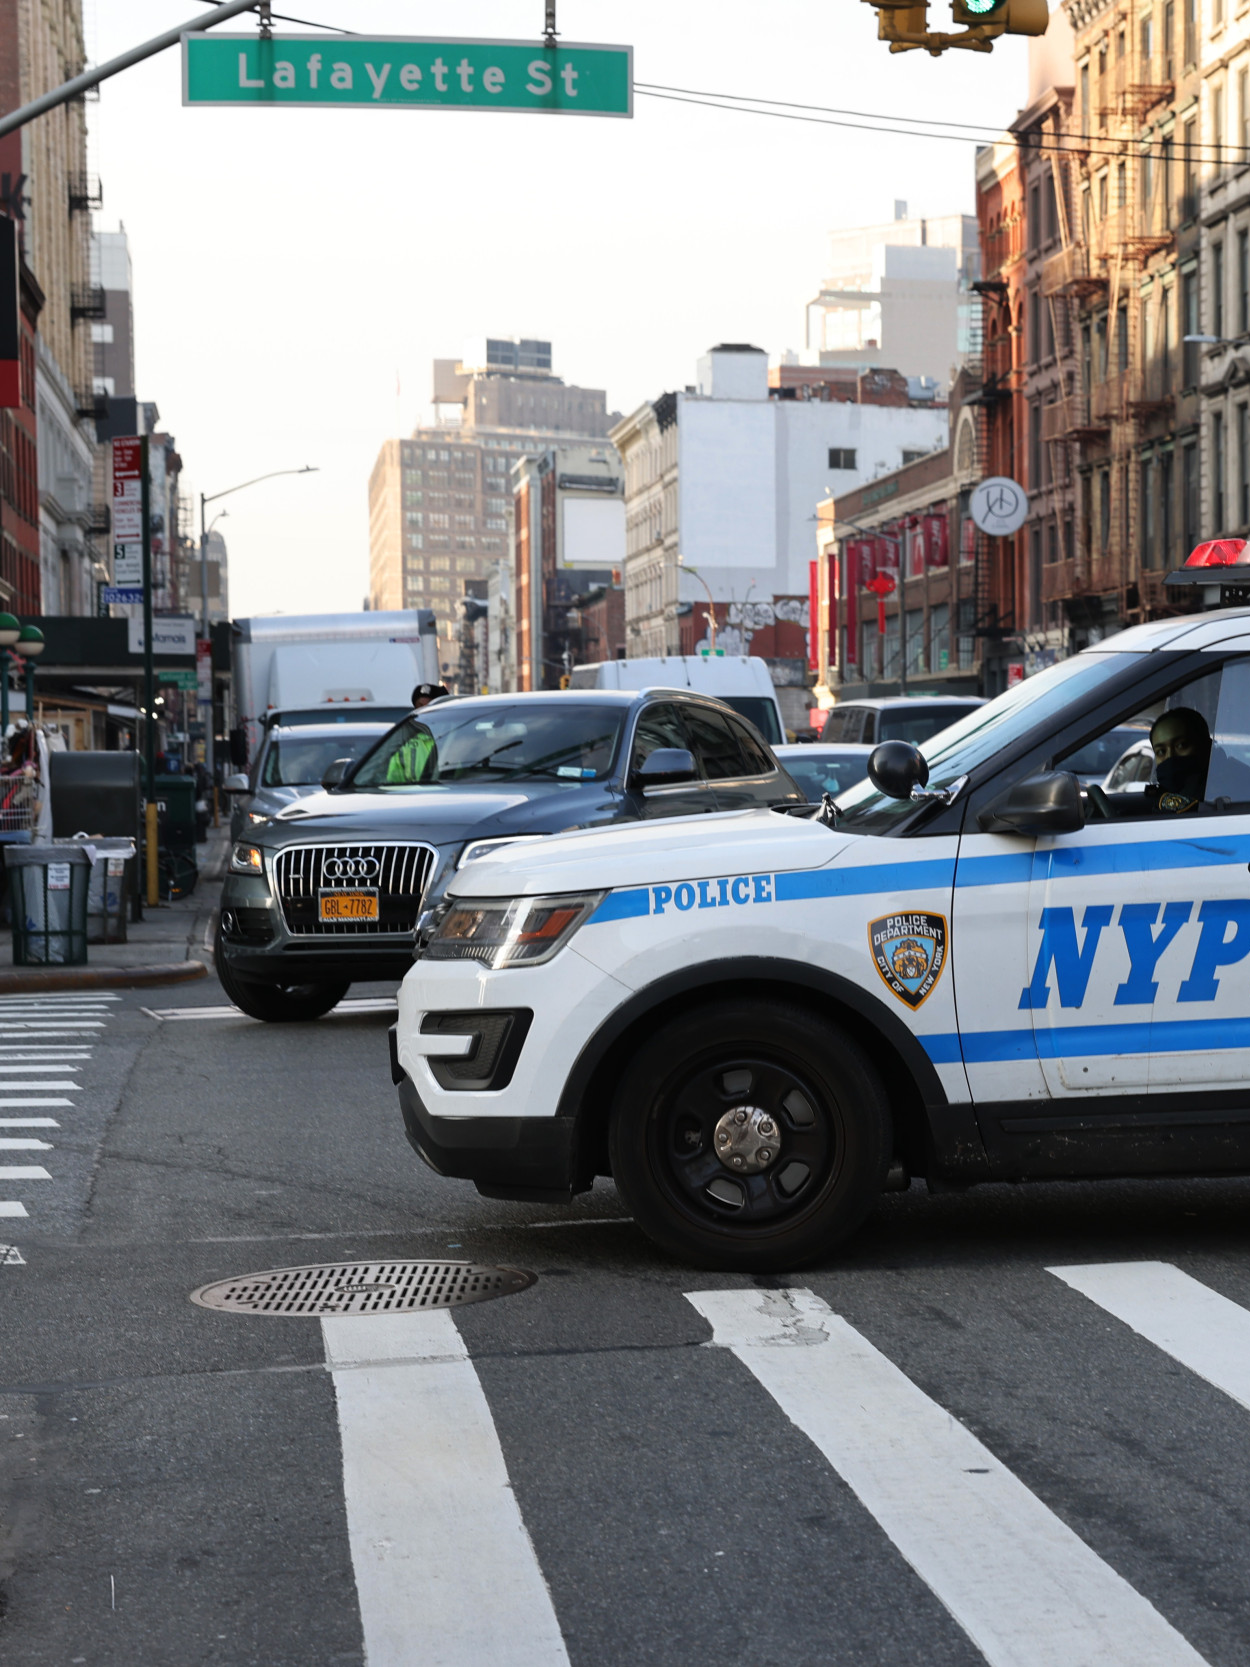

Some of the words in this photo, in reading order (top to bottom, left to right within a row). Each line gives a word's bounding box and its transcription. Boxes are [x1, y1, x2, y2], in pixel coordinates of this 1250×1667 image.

[238, 53, 506, 99] Lafayette
[525, 60, 579, 97] St
[115, 481, 122, 497] 3
[324, 899, 342, 915] GBL
[348, 899, 373, 915] 7782
[652, 874, 773, 915] POLICE
[873, 925, 943, 946] DEPARTMENT
[886, 914, 928, 929] POLICE
[877, 955, 893, 979] CITY
[891, 980, 905, 993] OF
[918, 974, 935, 996] NEW
[931, 945, 944, 972] YORK
